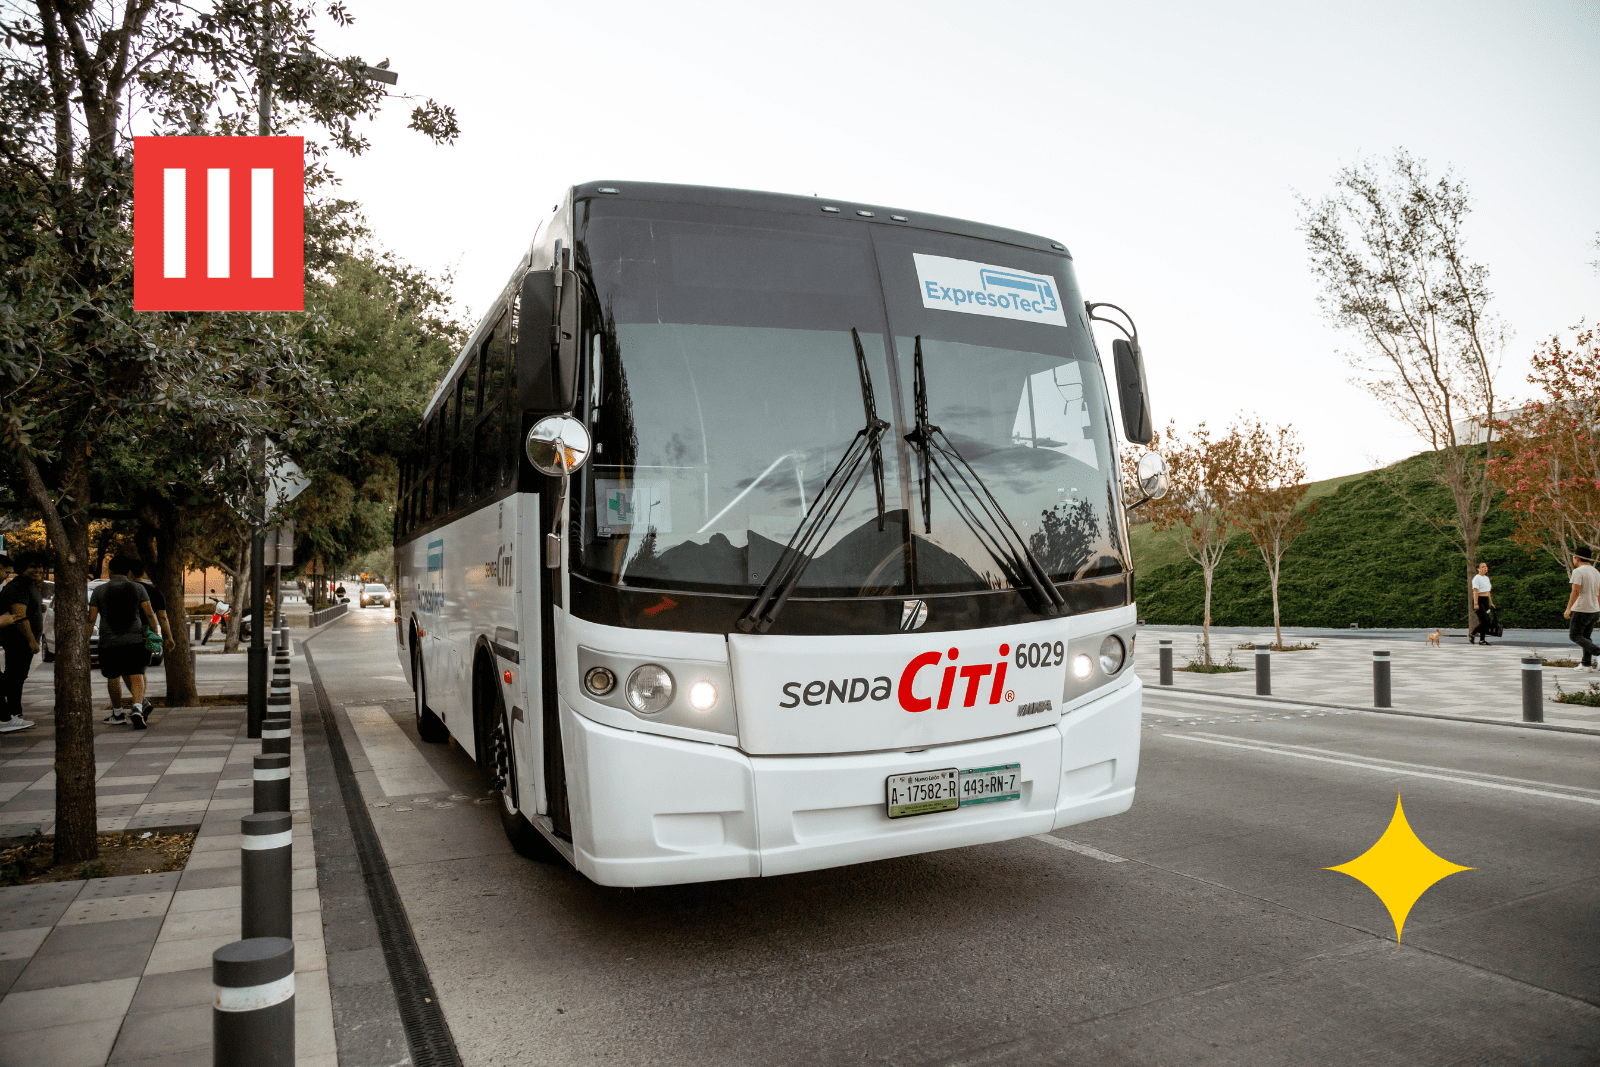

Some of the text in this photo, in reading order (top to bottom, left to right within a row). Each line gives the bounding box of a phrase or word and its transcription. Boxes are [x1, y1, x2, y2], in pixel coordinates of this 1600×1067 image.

[924, 281, 1043, 314] ExpresoTec
[1015, 640, 1065, 669] 6029
[891, 780, 956, 805] A-17582-R
[964, 774, 1016, 796] 443-RN-7
